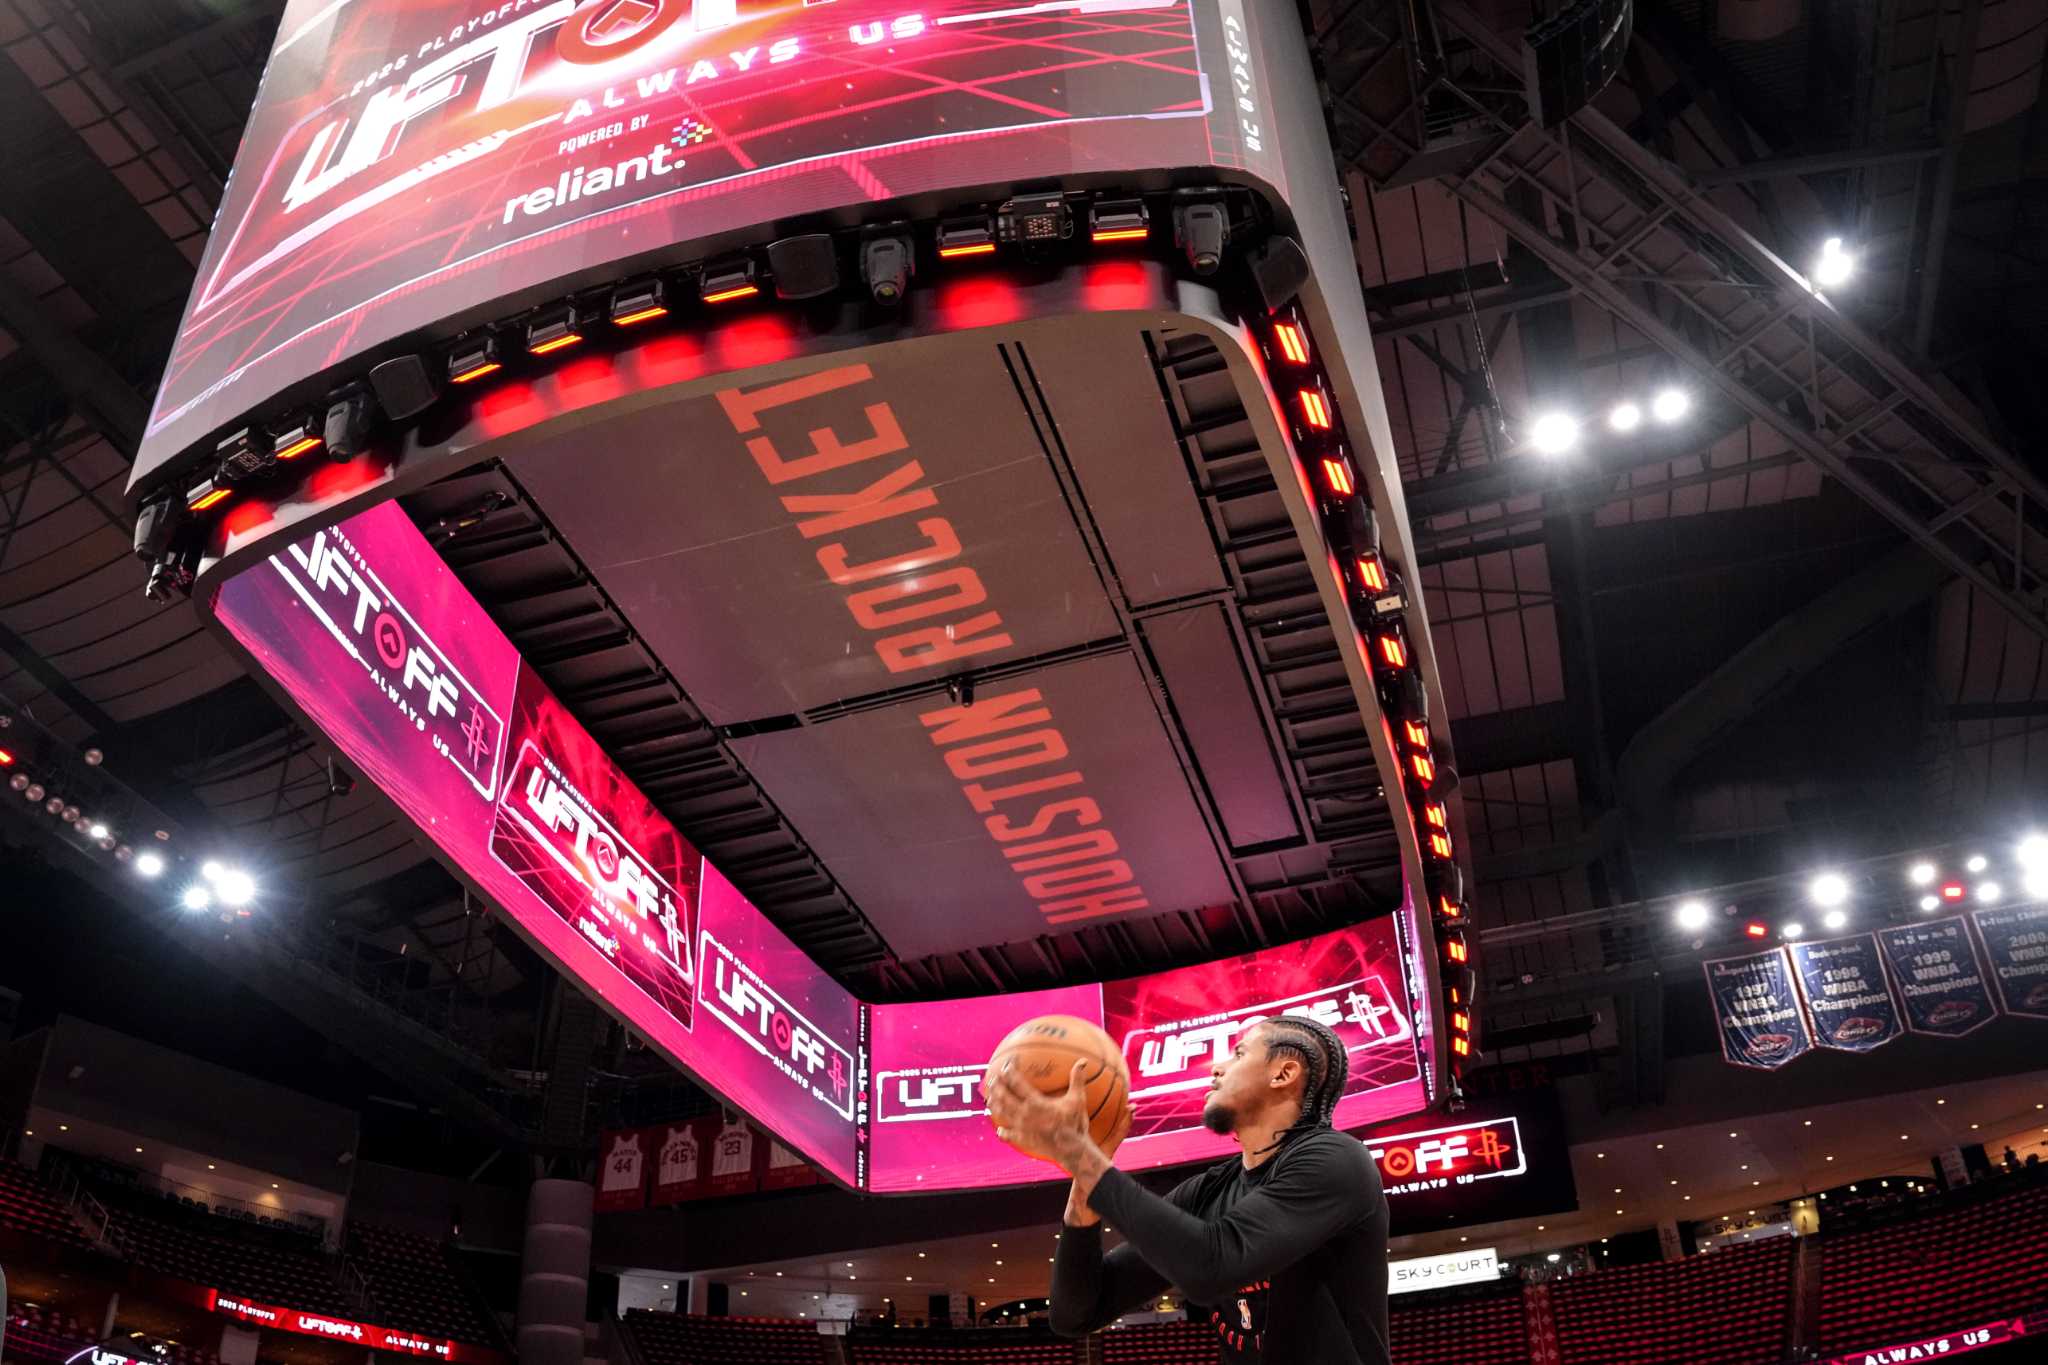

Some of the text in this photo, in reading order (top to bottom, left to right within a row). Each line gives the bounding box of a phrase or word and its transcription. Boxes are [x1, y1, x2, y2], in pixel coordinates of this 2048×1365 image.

[350, 0, 541, 98] 2025 PLAYOFF
[563, 14, 927, 125] ALWAYS US
[558, 113, 650, 155] POWERED BY
[502, 143, 687, 225] reliant.
[328, 525, 367, 571] AYOFFS
[370, 669, 450, 757] ALWAYS US
[918, 688, 1150, 924] HOUSTON
[526, 766, 660, 920] LIFTOFF
[2008, 931, 2046, 947] 2000
[1914, 950, 1951, 966] 1999
[1824, 966, 1860, 982] 1998
[1912, 962, 1960, 980] WNBA
[1823, 980, 1868, 996] WNBA
[1903, 975, 1979, 997] Champions
[1811, 992, 1888, 1012] Champions
[715, 956, 826, 1075] LIFTOFF
[1723, 1007, 1796, 1028] Champions
[773, 1055, 809, 1089] ALWAYS
[899, 1074, 987, 1108] LIFT
[671, 1148, 687, 1164] 45
[725, 1140, 740, 1155] 23
[1391, 1174, 1475, 1195] ALWAYS US
[299, 1316, 351, 1337] LIFTOFF
[386, 1335, 450, 1354] ALWAYS US
[1865, 1329, 1990, 1365] ALWAYS US
